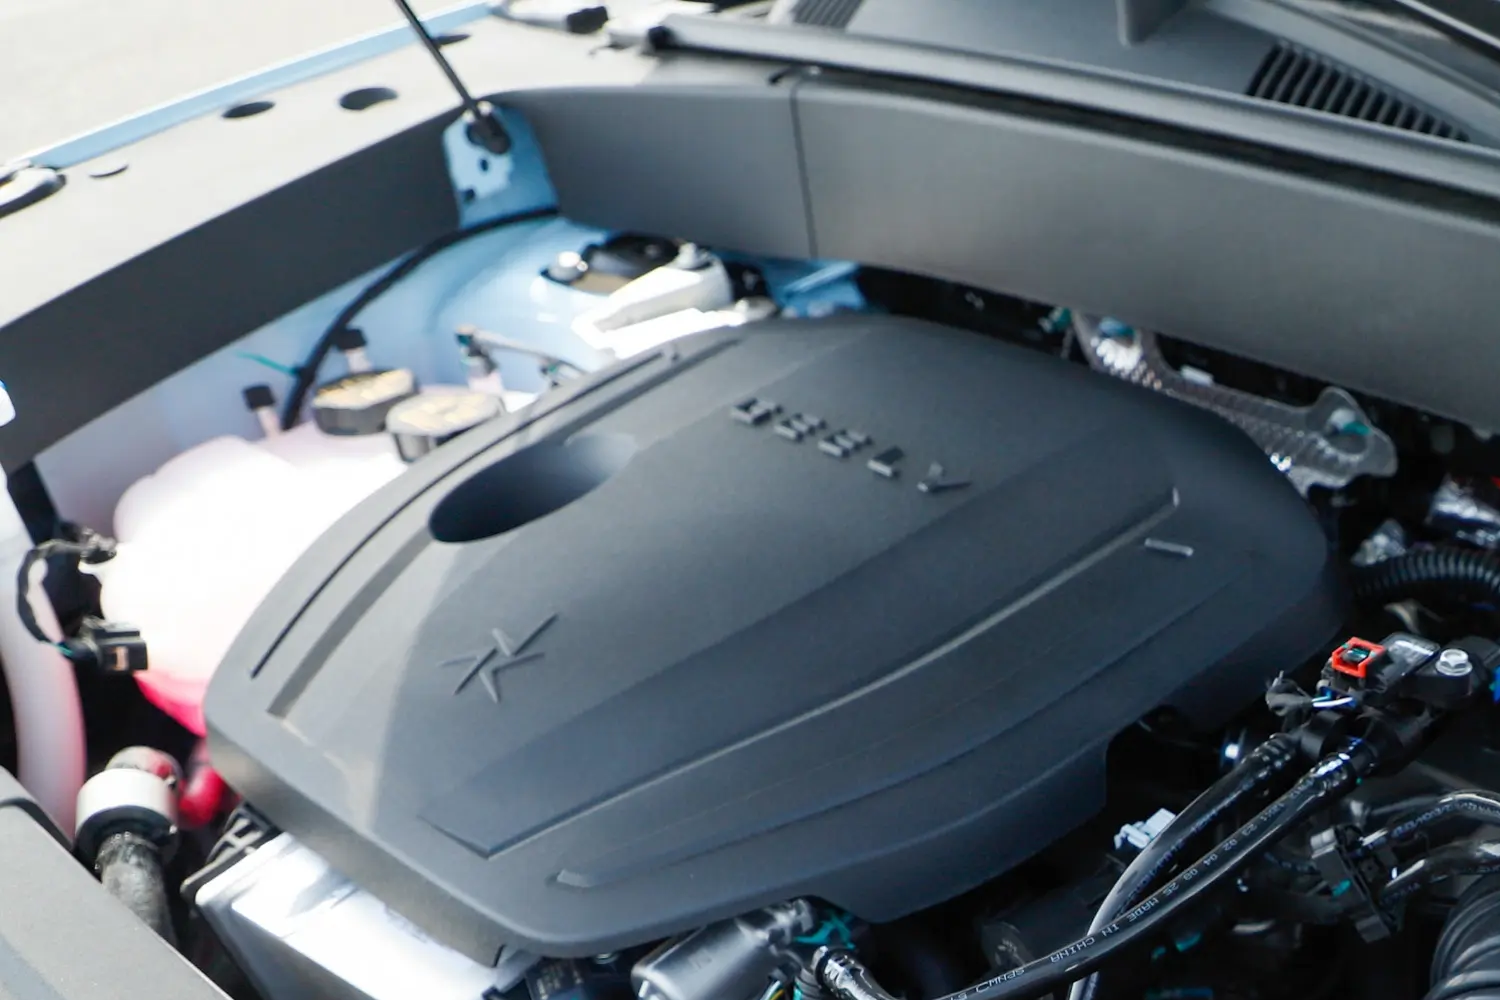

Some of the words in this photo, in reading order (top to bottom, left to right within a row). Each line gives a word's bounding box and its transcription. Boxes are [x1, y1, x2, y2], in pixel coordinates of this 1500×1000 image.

[1127, 897, 1159, 922] MADE
[1102, 923, 1120, 938] IN
[1050, 936, 1096, 963] CHINA
